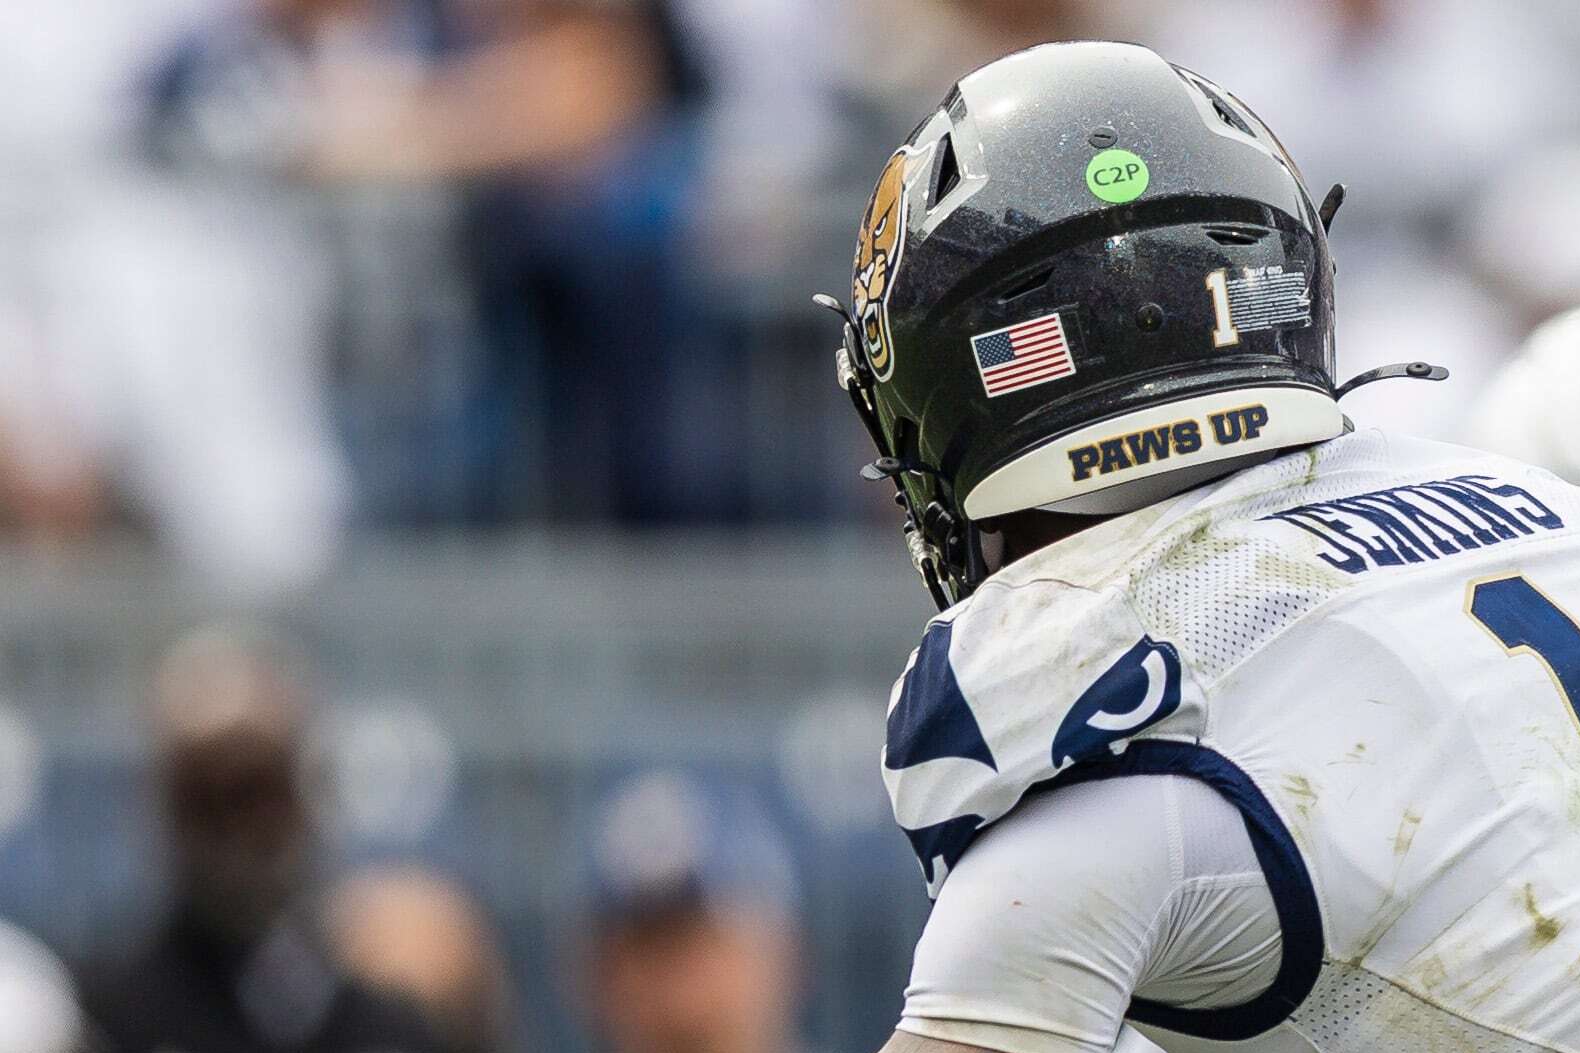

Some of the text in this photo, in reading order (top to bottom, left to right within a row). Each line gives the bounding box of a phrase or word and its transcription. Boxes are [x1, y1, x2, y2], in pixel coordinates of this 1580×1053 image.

[1093, 162, 1141, 187] C2P
[1205, 267, 1240, 348] 1
[1067, 403, 1270, 483] PAWS UP
[1254, 475, 1565, 575] JENKINS
